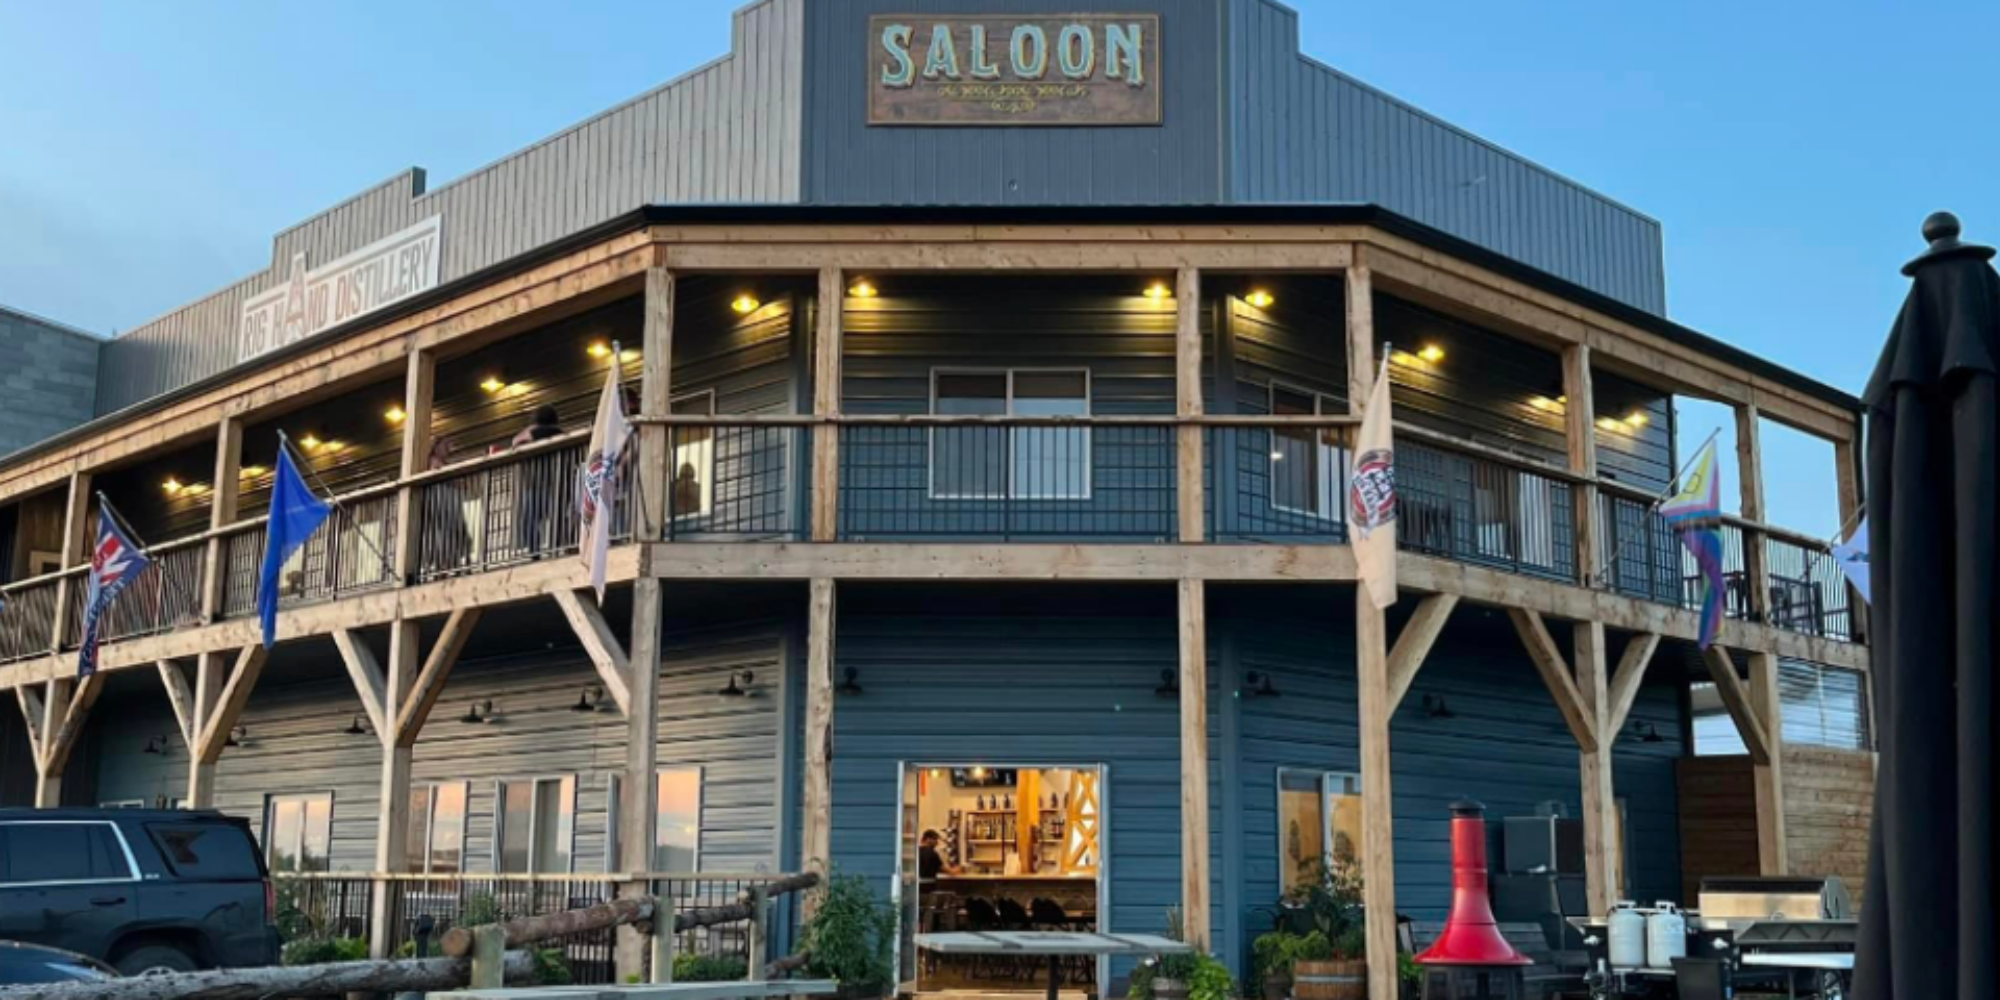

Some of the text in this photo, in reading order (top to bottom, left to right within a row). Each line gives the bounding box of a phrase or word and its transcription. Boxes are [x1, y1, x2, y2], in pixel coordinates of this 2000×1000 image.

[881, 24, 1144, 86] SALOON
[243, 236, 434, 360] RIG HAND DISTILLERY
